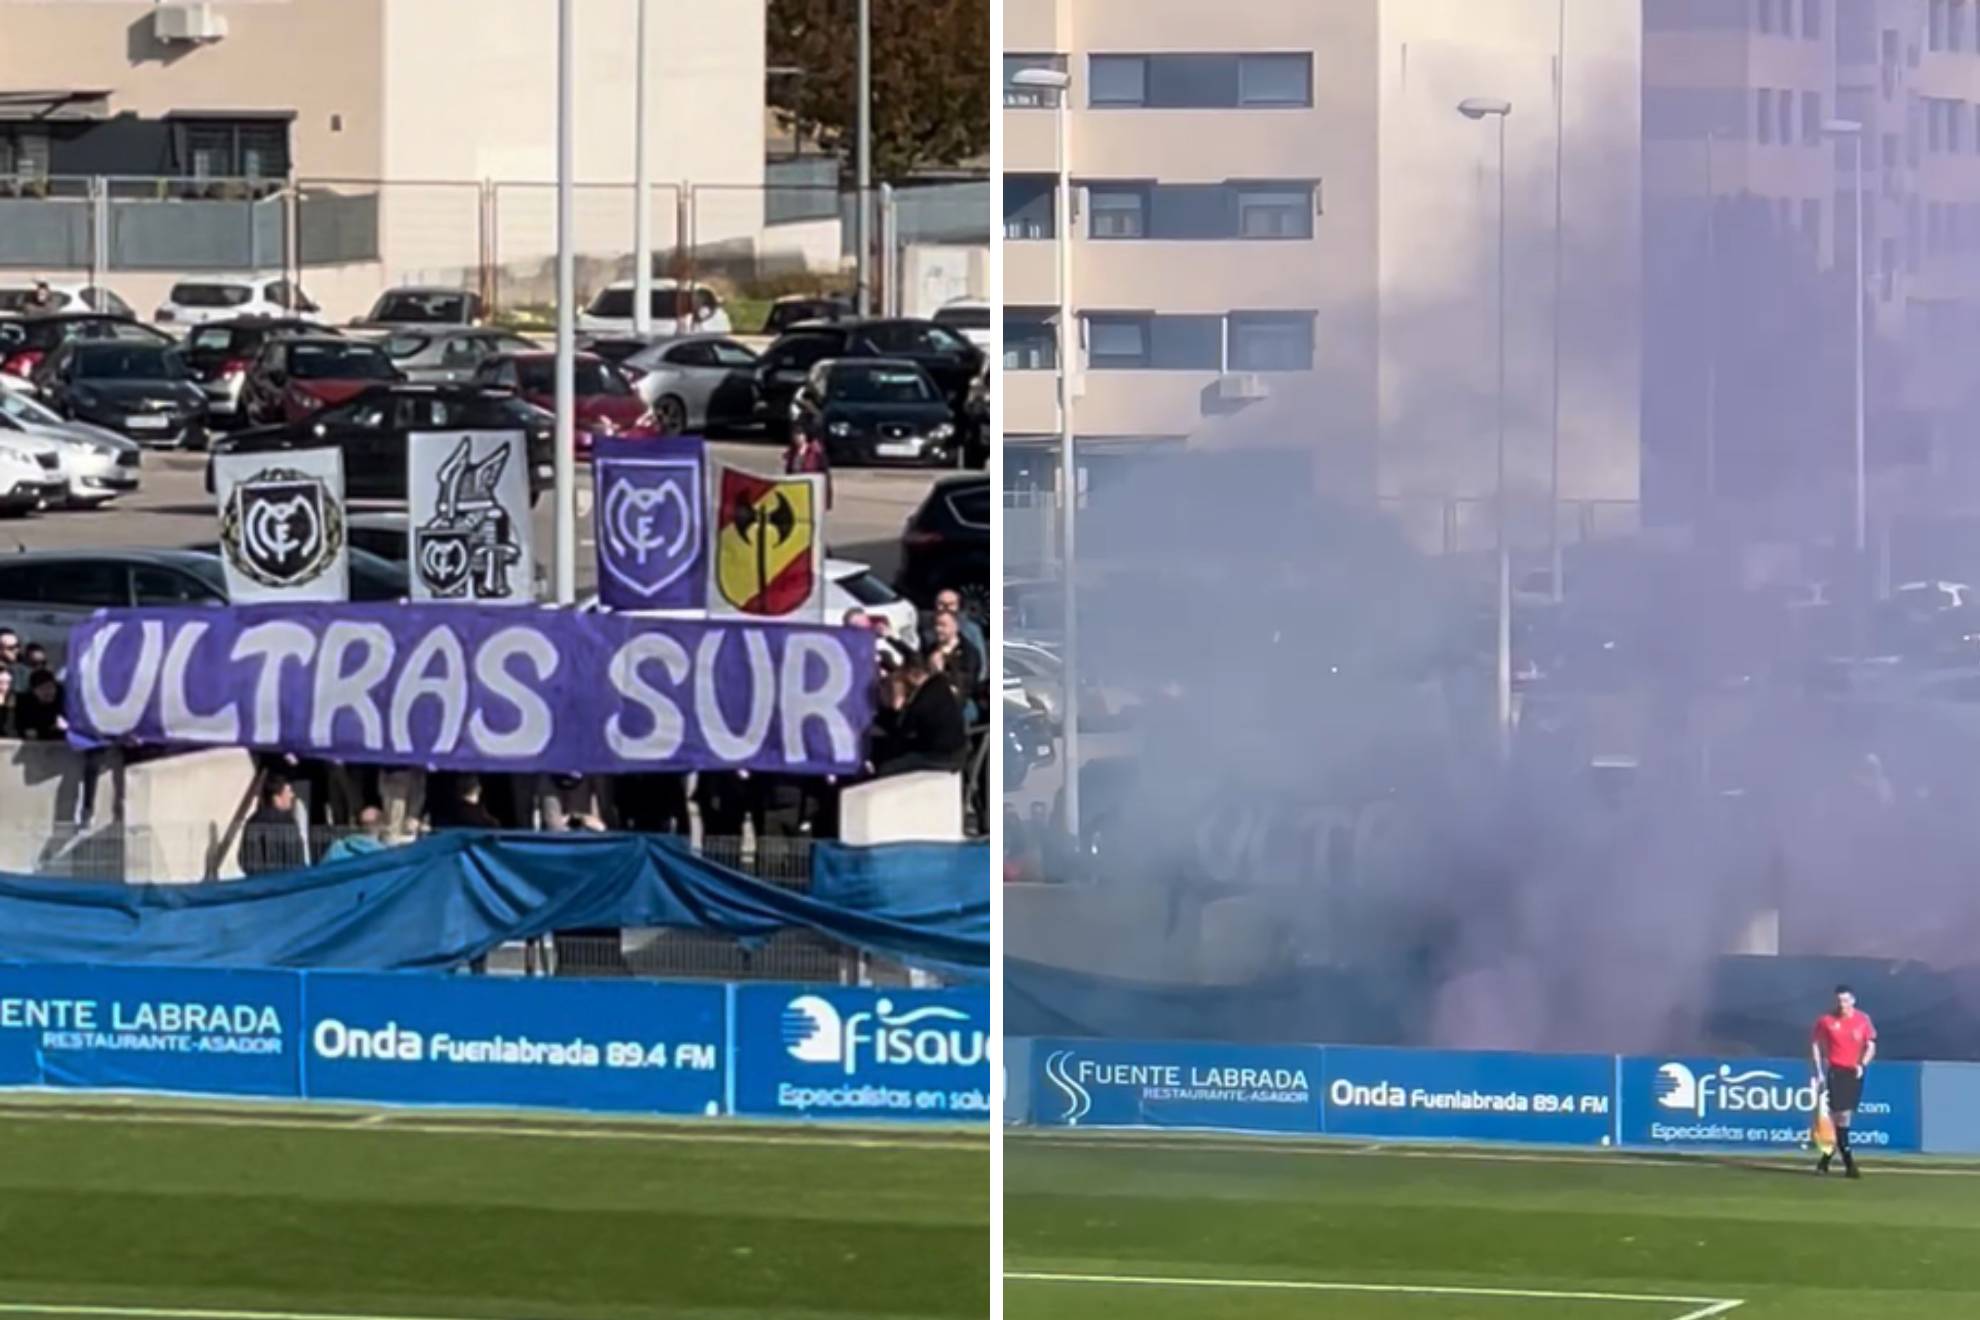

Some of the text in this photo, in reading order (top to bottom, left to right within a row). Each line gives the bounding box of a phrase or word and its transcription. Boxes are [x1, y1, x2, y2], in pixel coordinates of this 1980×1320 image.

[79, 619, 858, 763] ULTRAS SUR
[1, 998, 282, 1034] ENTE LABRADA
[43, 1031, 282, 1055] RESTAURANTE-ASADOR
[314, 1019, 717, 1070] Onda Fuenlabrada 89.4 FM
[844, 1000, 990, 1075] fisau
[1078, 1060, 1309, 1090] FUENTE LABRADA
[777, 1083, 990, 1111] Especialistas en salu
[1331, 1079, 1609, 1113] Onda Fuenlabrada 89.4 FM
[1652, 1122, 1890, 1146] Especialistas en salud porte
